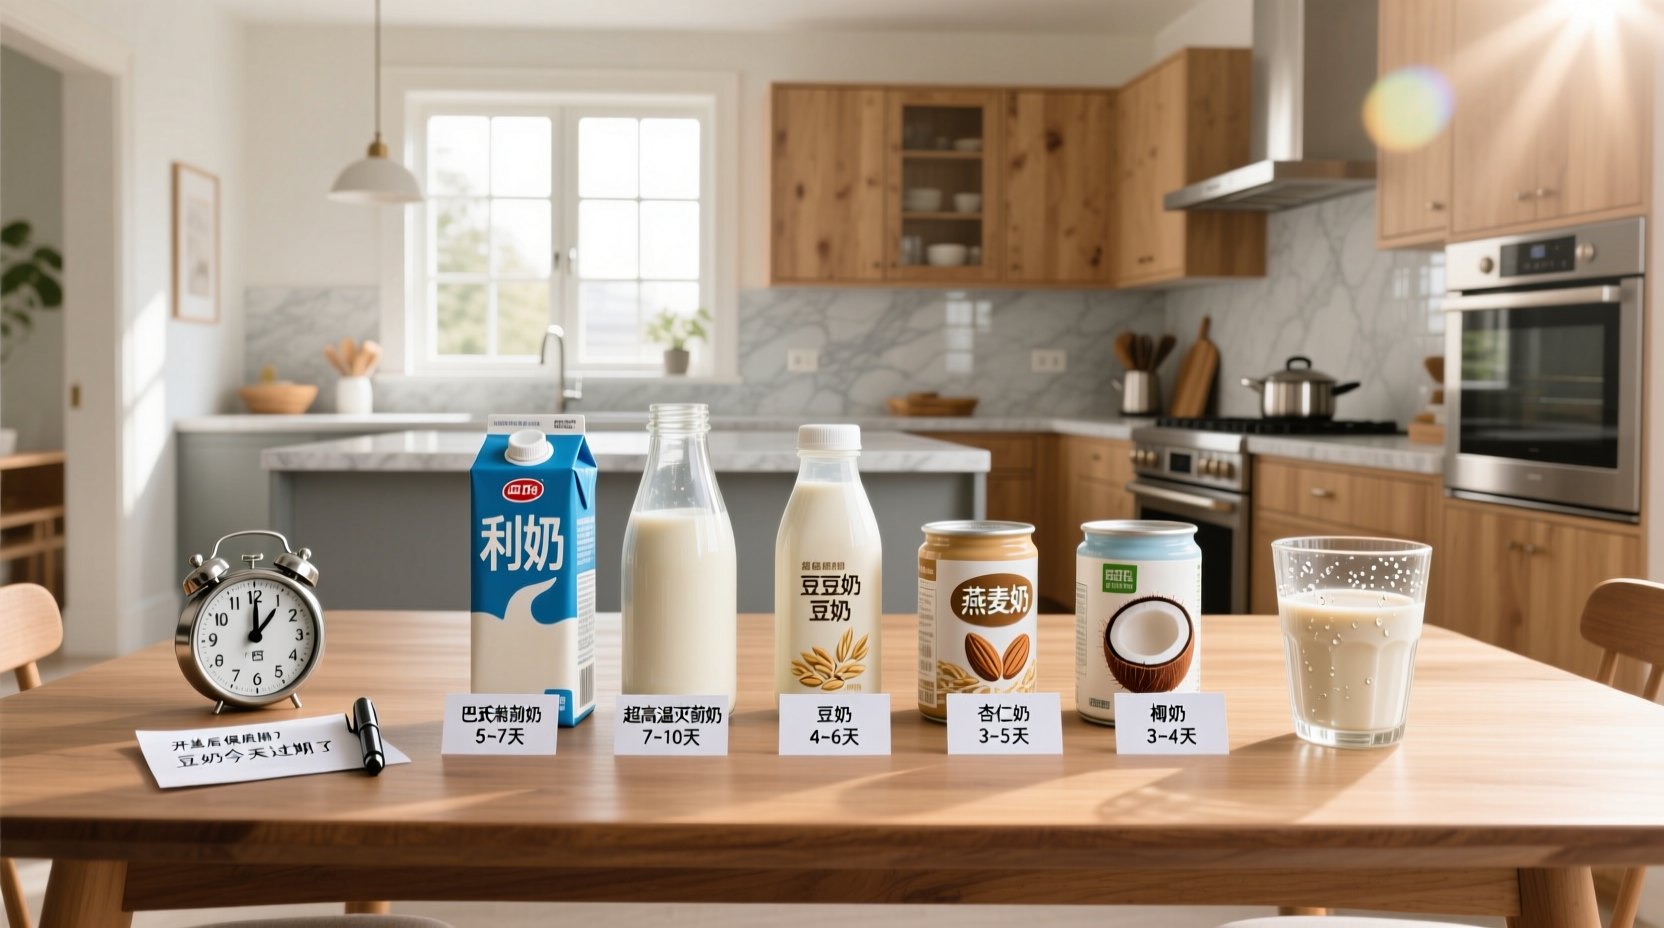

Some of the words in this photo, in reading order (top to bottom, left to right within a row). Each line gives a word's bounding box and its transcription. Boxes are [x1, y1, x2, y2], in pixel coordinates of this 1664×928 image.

[479, 513, 565, 572] 利奶
[800, 573, 861, 596] 豆豆奶
[229, 596, 240, 610] 11
[247, 589, 262, 605] 12
[276, 594, 280, 607] 1
[961, 583, 1029, 616] 燕麦奶
[288, 608, 298, 622] 2
[809, 599, 851, 622] 豆奶
[215, 612, 229, 627] 10
[208, 632, 218, 647] 9
[295, 628, 304, 641] 3
[214, 653, 224, 667] 8
[288, 648, 298, 661] 4
[231, 669, 241, 682] 7
[252, 672, 262, 686] 6
[274, 664, 284, 678] 5
[816, 705, 852, 723] 豆奶
[977, 703, 1030, 722] 杏仁奶
[475, 728, 525, 745] 5-7天
[642, 728, 700, 746] 7-10天
[809, 728, 859, 746] 4-6天
[978, 727, 1029, 745] 3-5天
[1146, 727, 1197, 745] 3-4天
